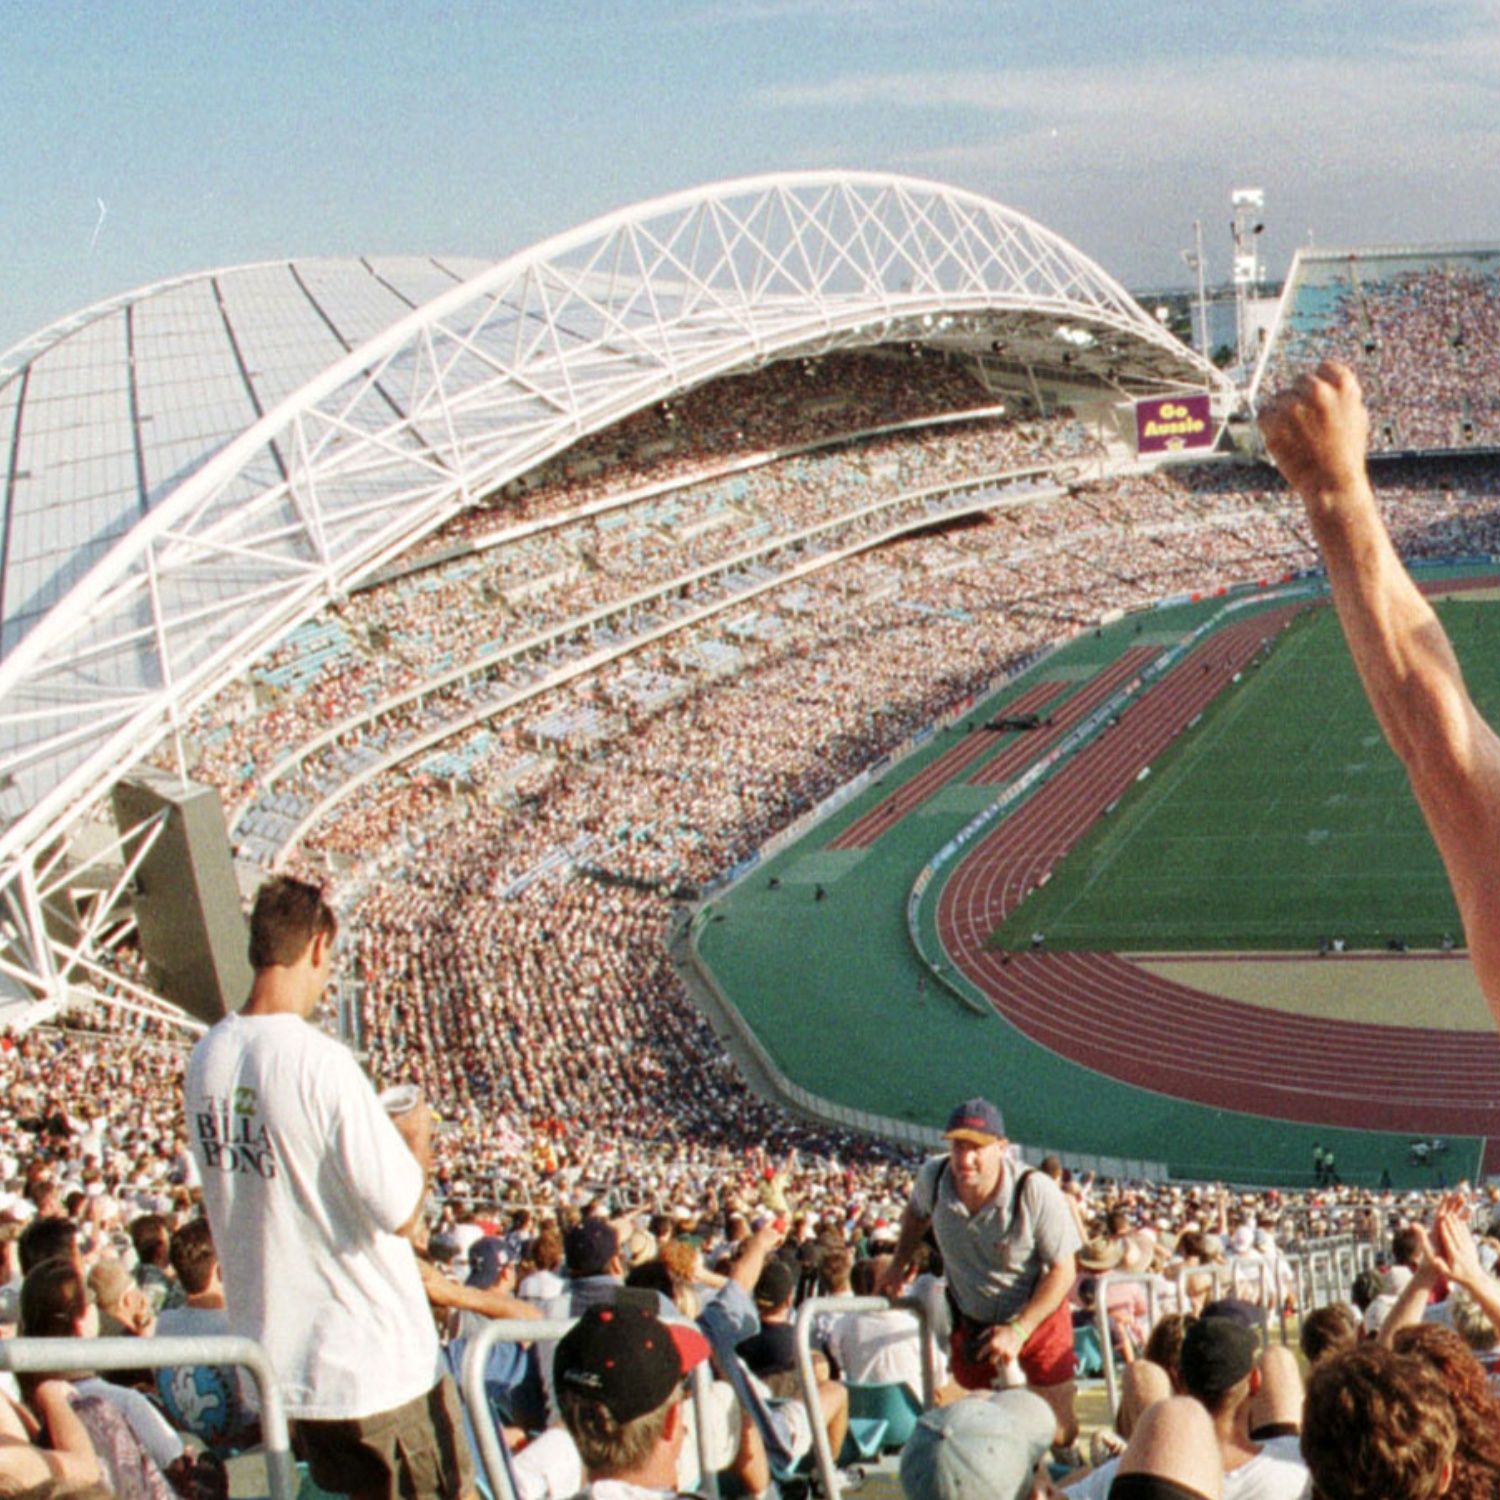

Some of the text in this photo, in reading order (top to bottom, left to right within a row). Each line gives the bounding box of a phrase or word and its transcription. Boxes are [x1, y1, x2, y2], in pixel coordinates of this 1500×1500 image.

[1158, 403, 1188, 419] Go
[1143, 416, 1205, 438] Aussie
[202, 1141, 276, 1179] PONG
